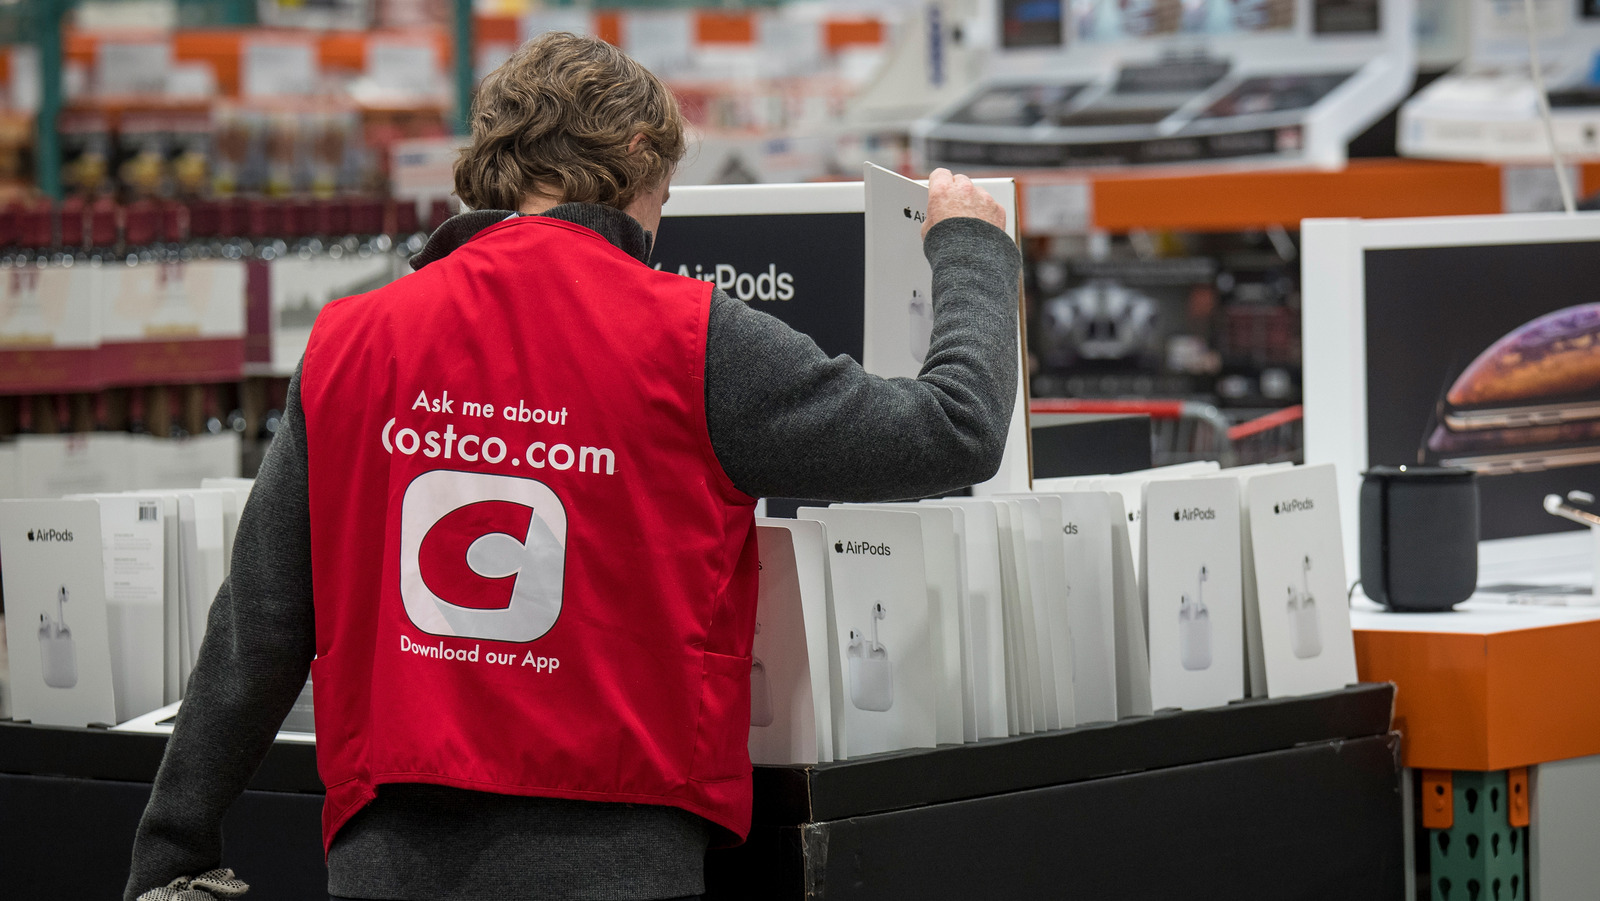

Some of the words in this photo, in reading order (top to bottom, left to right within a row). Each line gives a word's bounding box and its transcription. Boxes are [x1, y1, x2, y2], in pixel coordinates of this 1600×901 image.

[677, 262, 795, 301] Pods
[411, 390, 454, 414] Ask
[462, 401, 494, 418] me
[503, 400, 568, 425] about
[1281, 497, 1314, 513] AirPods
[1181, 507, 1215, 521] AirPods
[36, 528, 73, 542] AirPods
[845, 541, 891, 556] AirPods
[401, 635, 479, 663] Download
[486, 651, 517, 666] our
[521, 650, 560, 674] App
